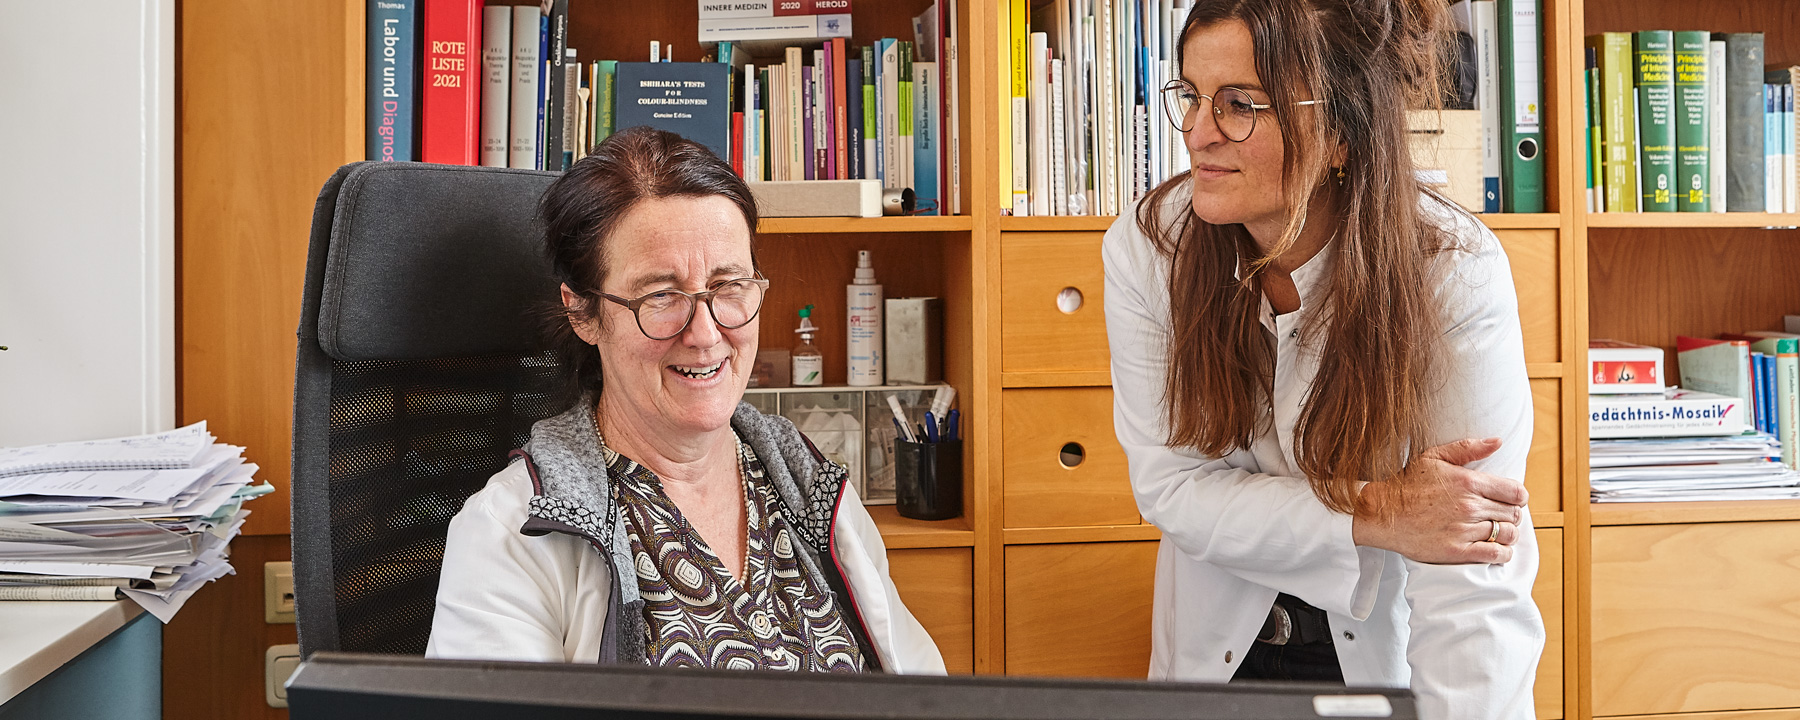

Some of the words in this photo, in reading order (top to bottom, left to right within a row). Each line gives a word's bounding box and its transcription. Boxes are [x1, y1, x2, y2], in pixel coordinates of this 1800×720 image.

[377, 2, 406, 10] Thomas
[816, 0, 848, 8] HEROLD
[556, 14, 564, 39] Arztpraxis
[384, 18, 400, 64] Labor
[432, 41, 466, 55] ROTE
[1641, 54, 1671, 64] Principles
[1677, 54, 1708, 64] Principles
[432, 58, 465, 71] LISTE
[1640, 64, 1648, 72] of
[1649, 64, 1672, 72] Internal
[1676, 64, 1684, 72] of
[1685, 64, 1708, 72] Internal
[432, 74, 461, 88] 2021
[1643, 72, 1672, 82] Medicine
[1679, 72, 1708, 82] Medicine
[383, 67, 400, 98] und
[778, 500, 797, 524] CMP
